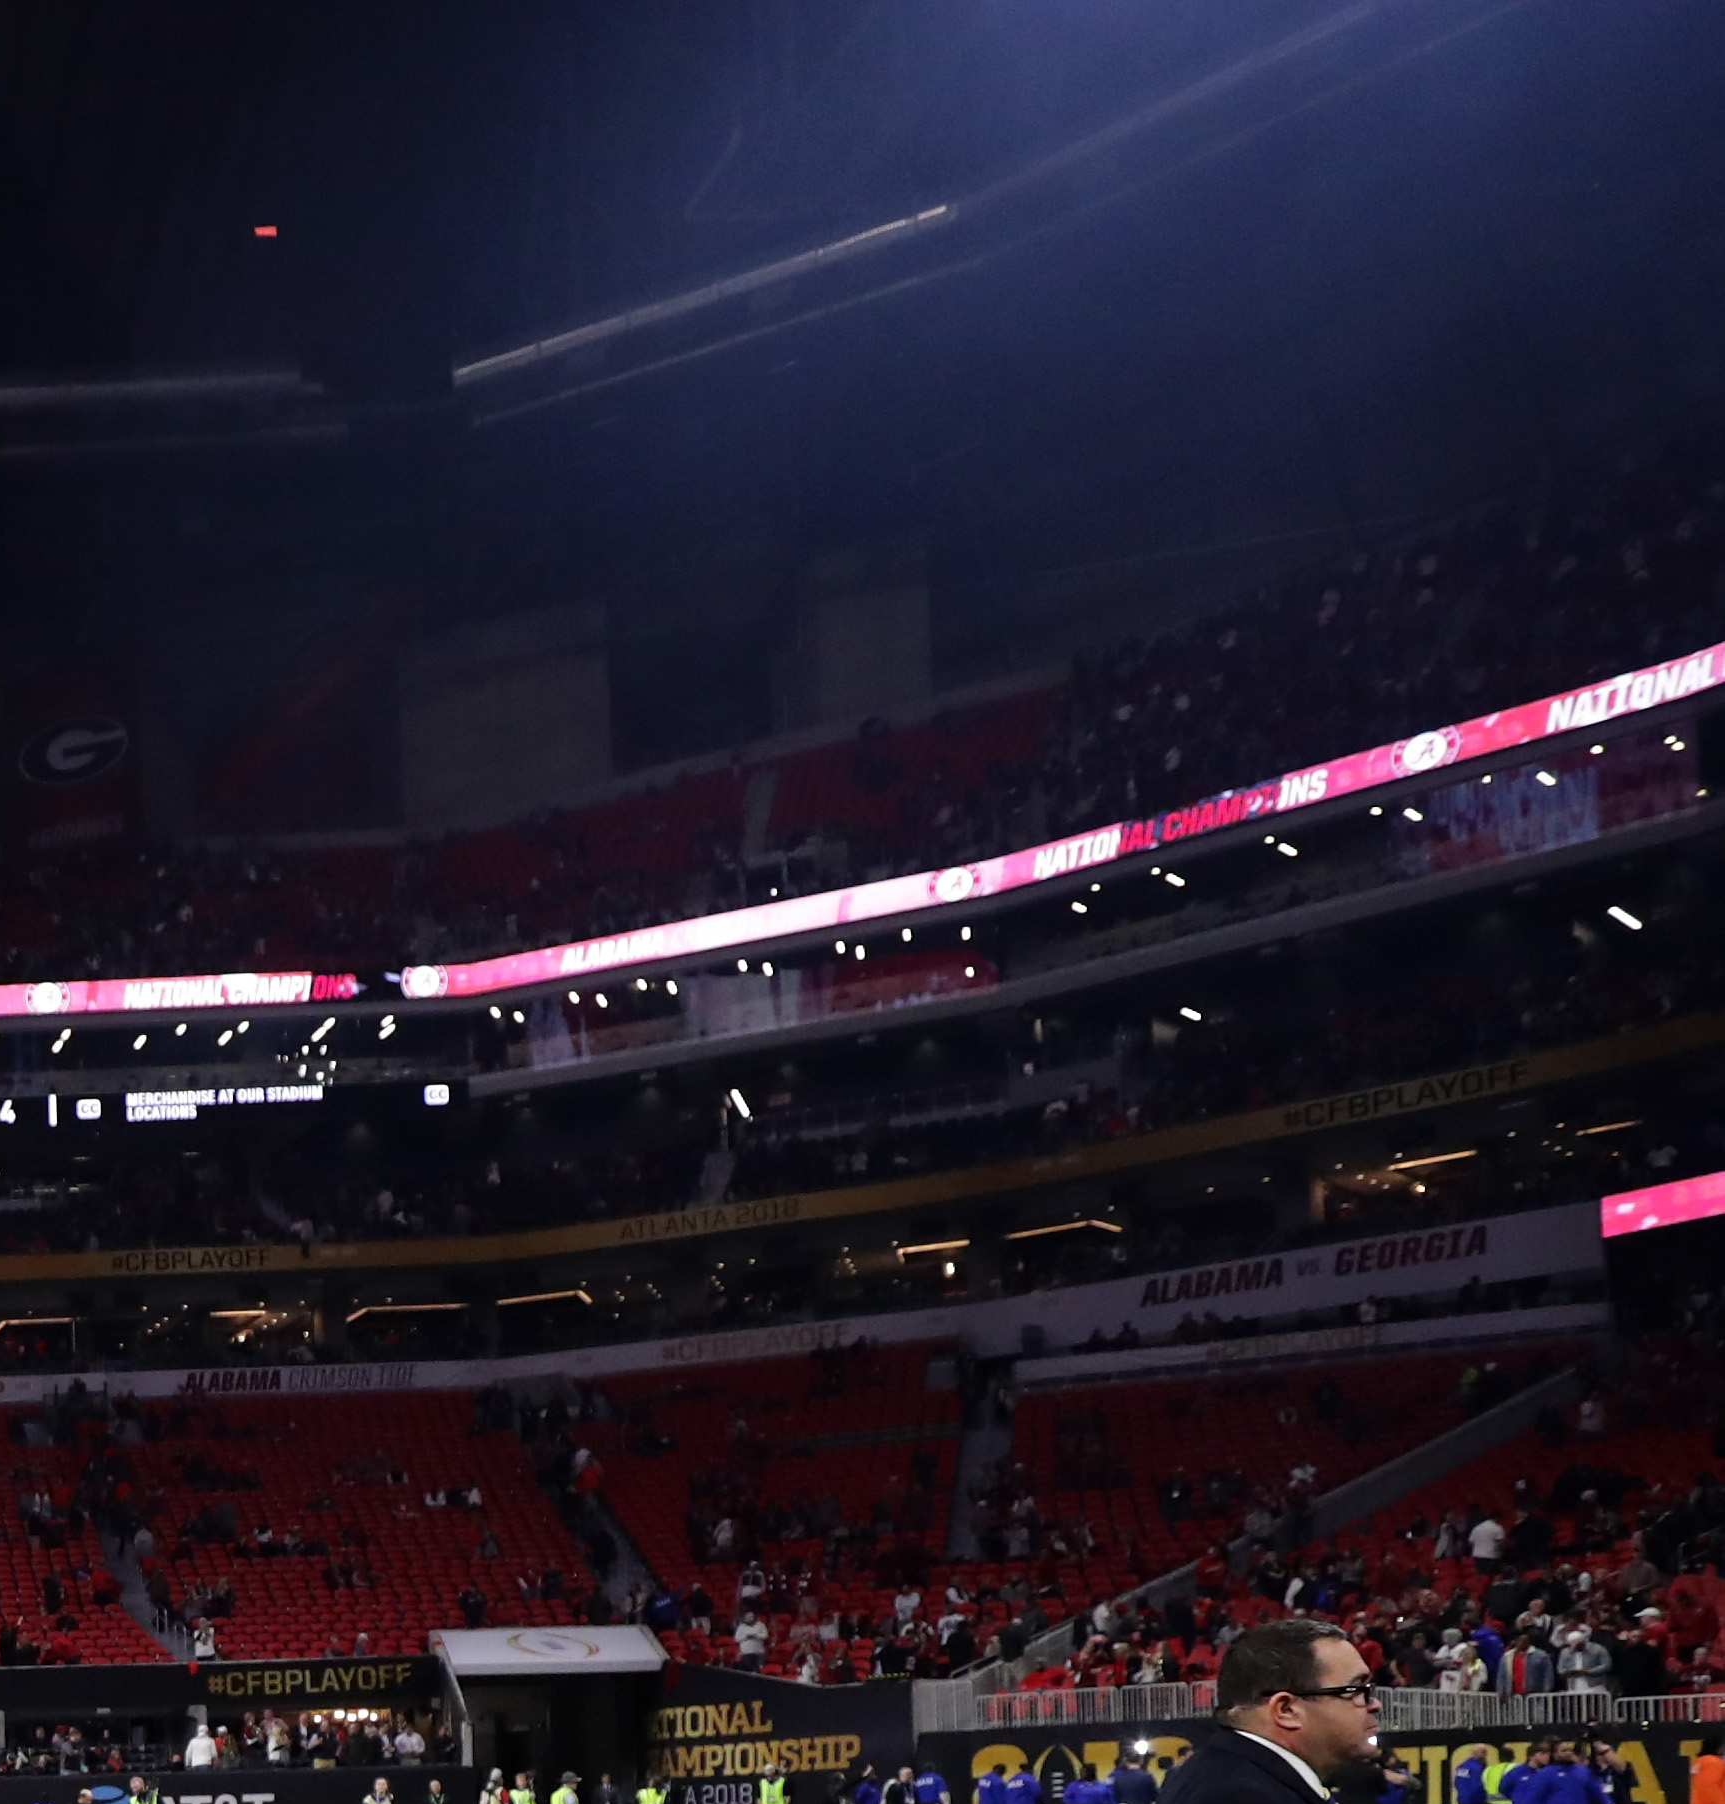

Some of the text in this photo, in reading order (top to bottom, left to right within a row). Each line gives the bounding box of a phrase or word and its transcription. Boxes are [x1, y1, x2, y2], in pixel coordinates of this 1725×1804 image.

[1545, 652, 1716, 734] NATIONAL
[1034, 769, 1329, 880] NATIONAL CHAMPIONS
[561, 931, 665, 973] ALABAMA
[123, 973, 357, 1010] NATIONAL CHAMPIONS
[126, 1085, 324, 1107] MERCHANDISE AT OUR STADIUM
[1285, 1059, 1530, 1127] #CFBPLAYOFF
[126, 1105, 197, 1123] LOCATIONS
[620, 1209, 728, 1240] ATLANTA
[111, 1248, 271, 1274] #CFBPLAYOFF
[1141, 1258, 1284, 1308] ALABAMA
[1334, 1225, 1488, 1276] GEORGIA
[186, 1370, 282, 1394] ALABAMA
[207, 1663, 413, 1697] #CFBPLAYOFF
